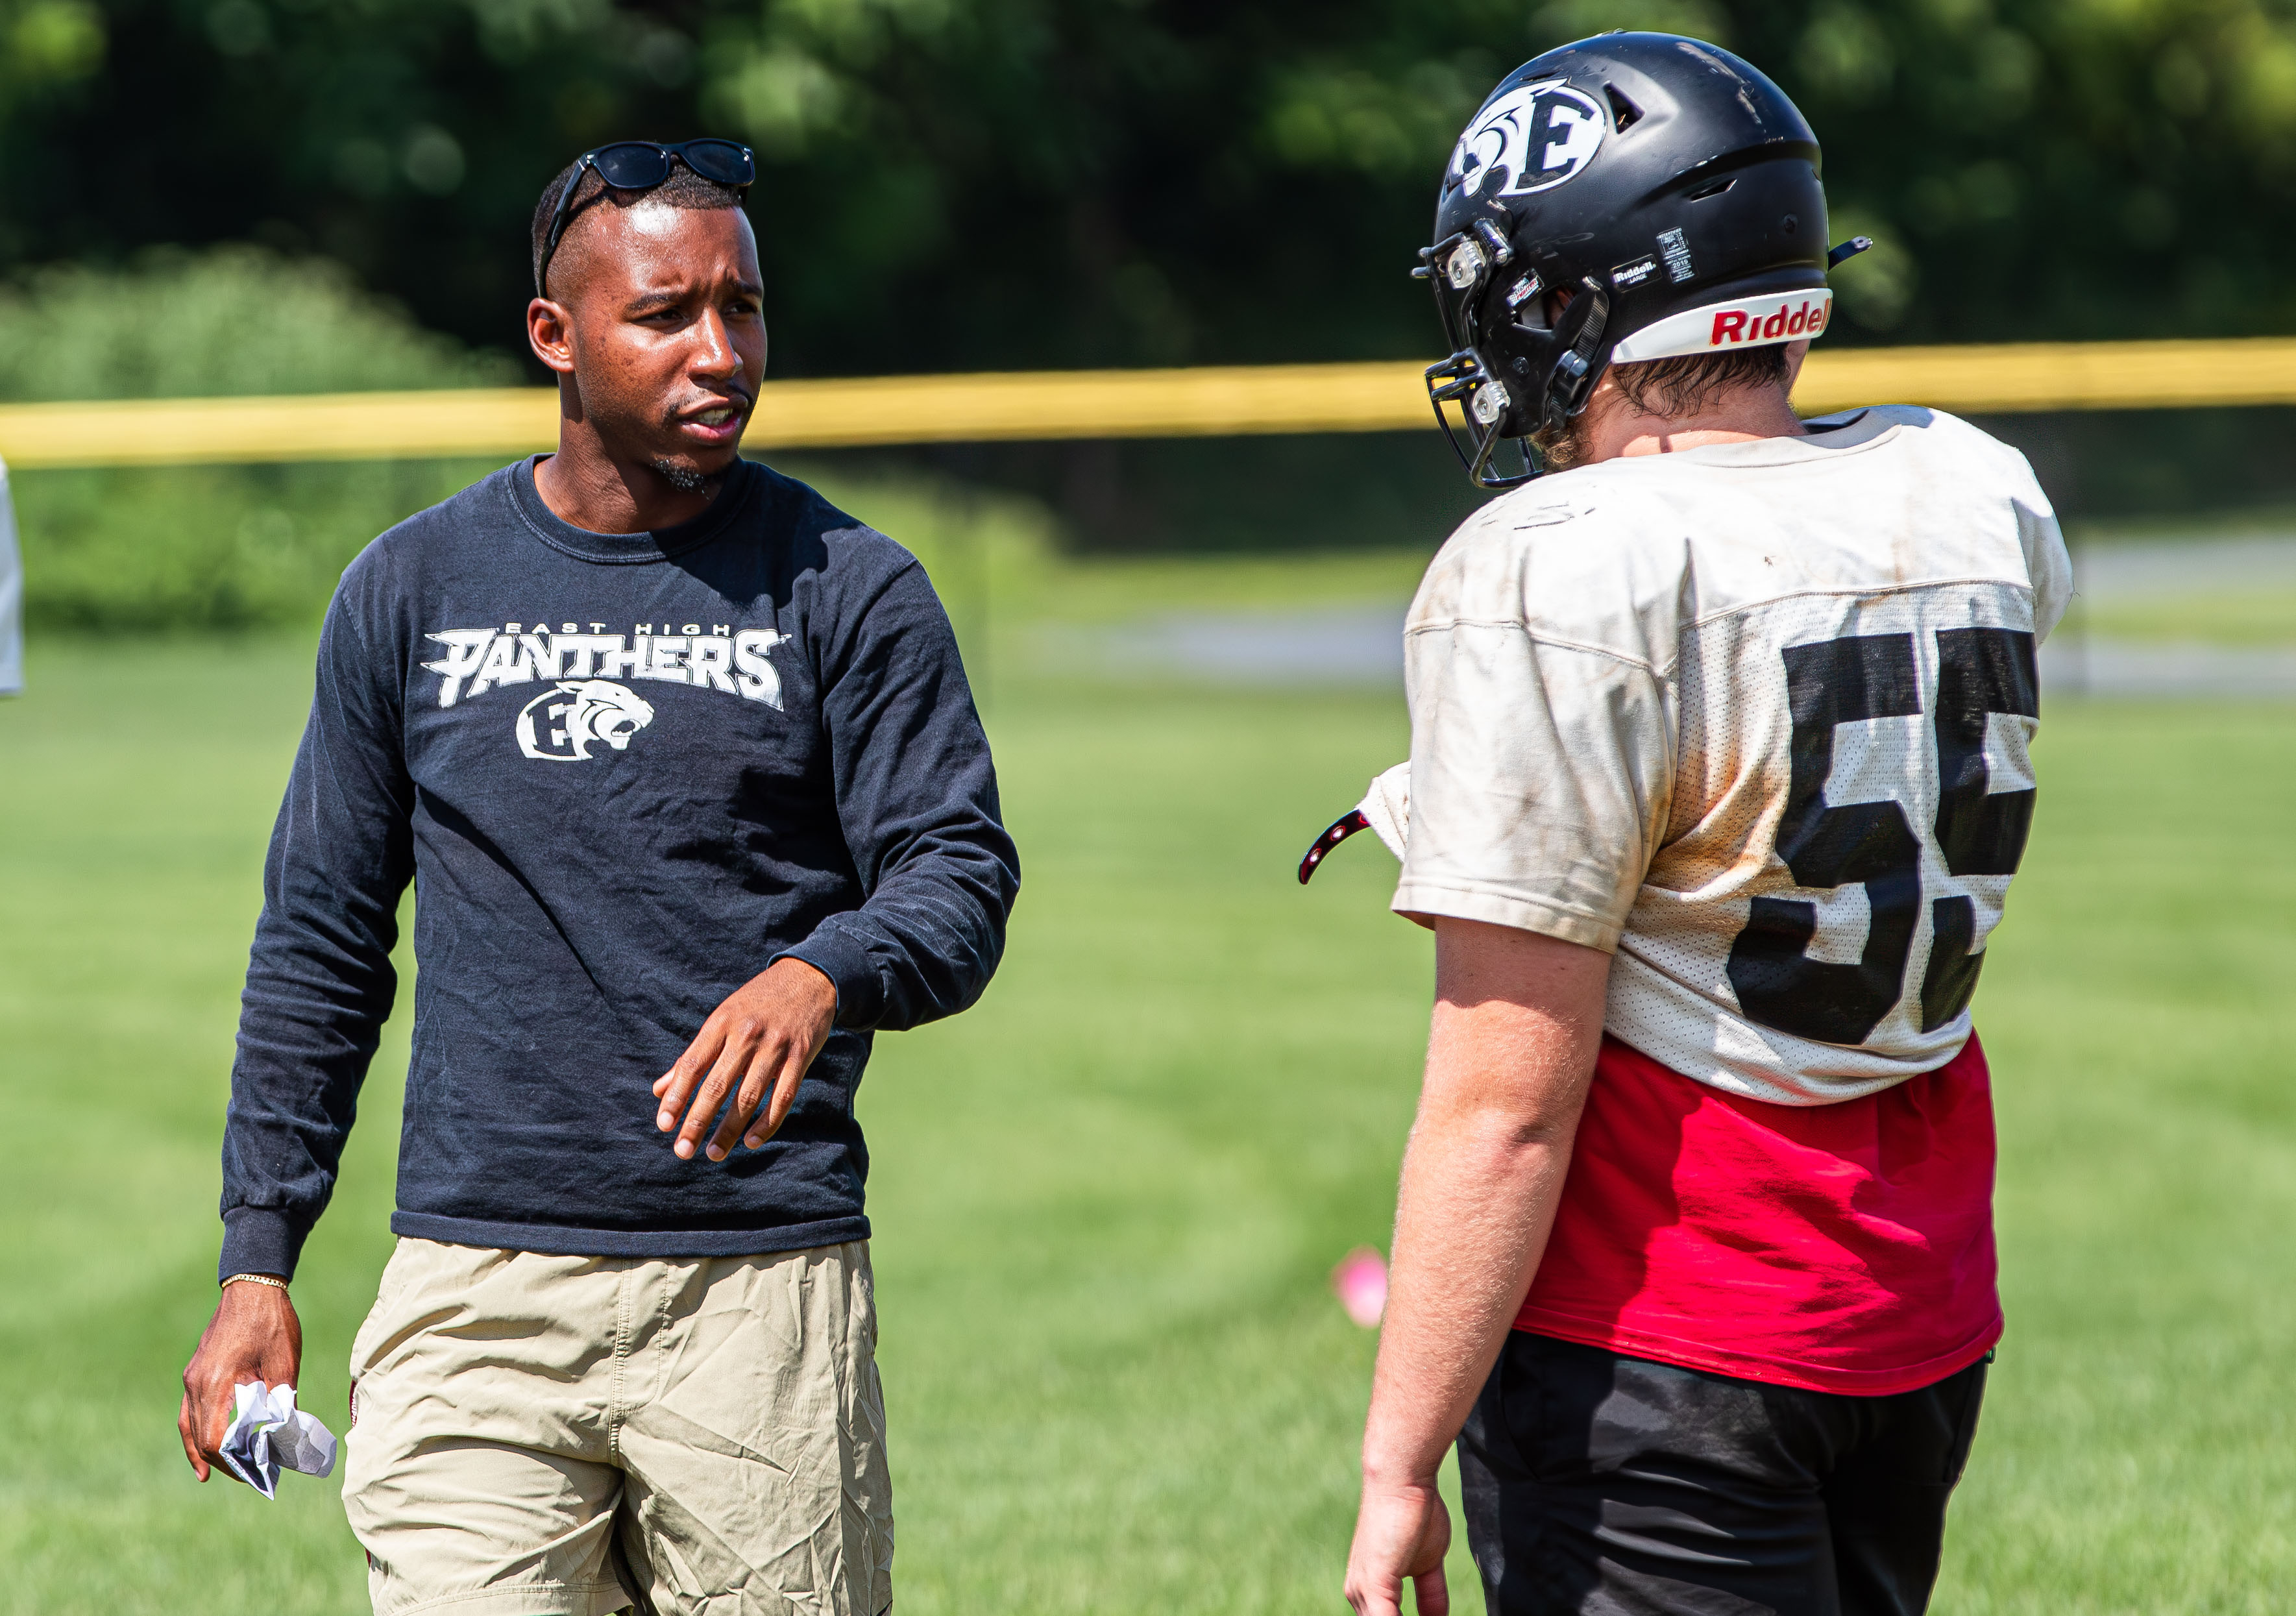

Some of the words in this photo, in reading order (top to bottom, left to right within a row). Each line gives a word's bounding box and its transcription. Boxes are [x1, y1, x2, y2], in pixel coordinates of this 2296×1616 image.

[1613, 262, 1656, 283] Riddell
[1672, 259, 1689, 269] 2019
[1629, 273, 1648, 284] LARGE
[505, 622, 606, 634] EAST
[635, 623, 730, 635] HIGH
[421, 629, 792, 712] PANTHERS
[1726, 627, 2040, 1046] 55
